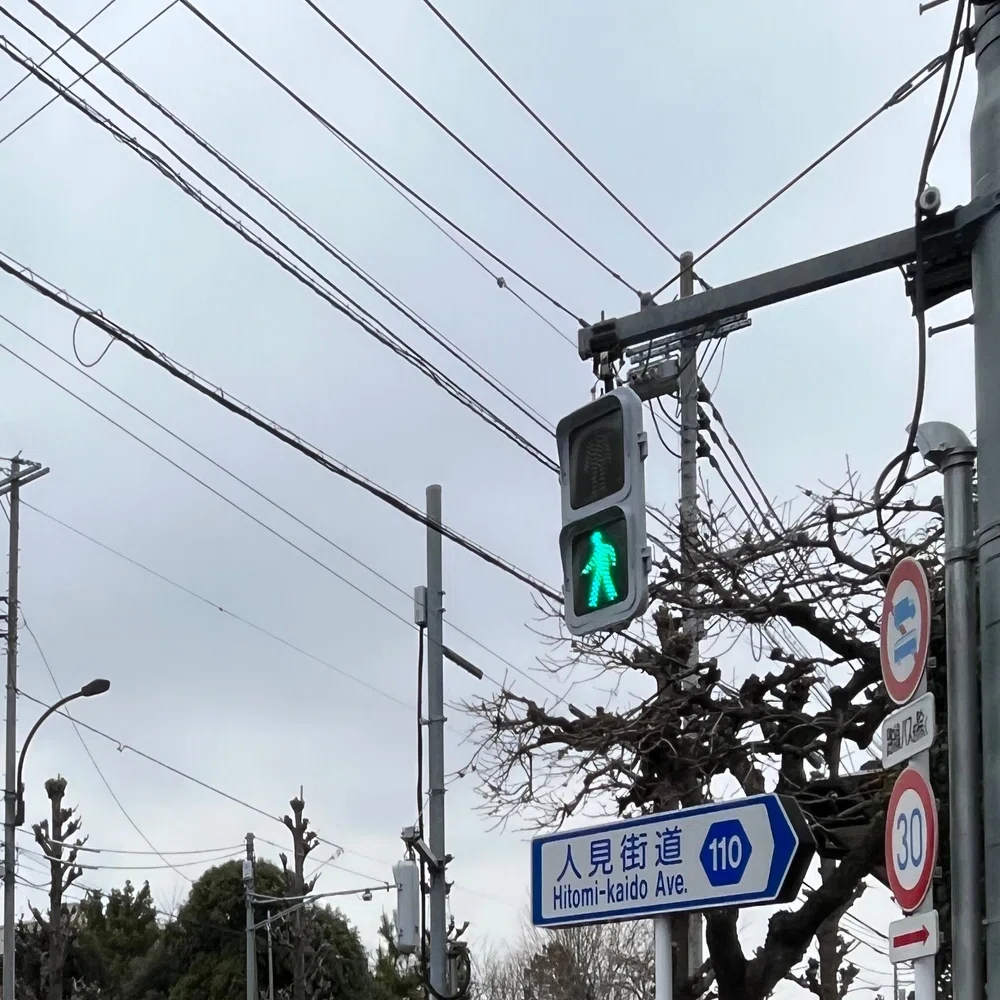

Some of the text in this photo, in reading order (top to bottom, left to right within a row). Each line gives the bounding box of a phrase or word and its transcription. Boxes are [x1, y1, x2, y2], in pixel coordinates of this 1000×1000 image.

[556, 825, 683, 882] 人見街道
[709, 835, 742, 872] 110
[896, 807, 923, 872] 30
[553, 871, 688, 911] Hitomi-kaido Ave.
